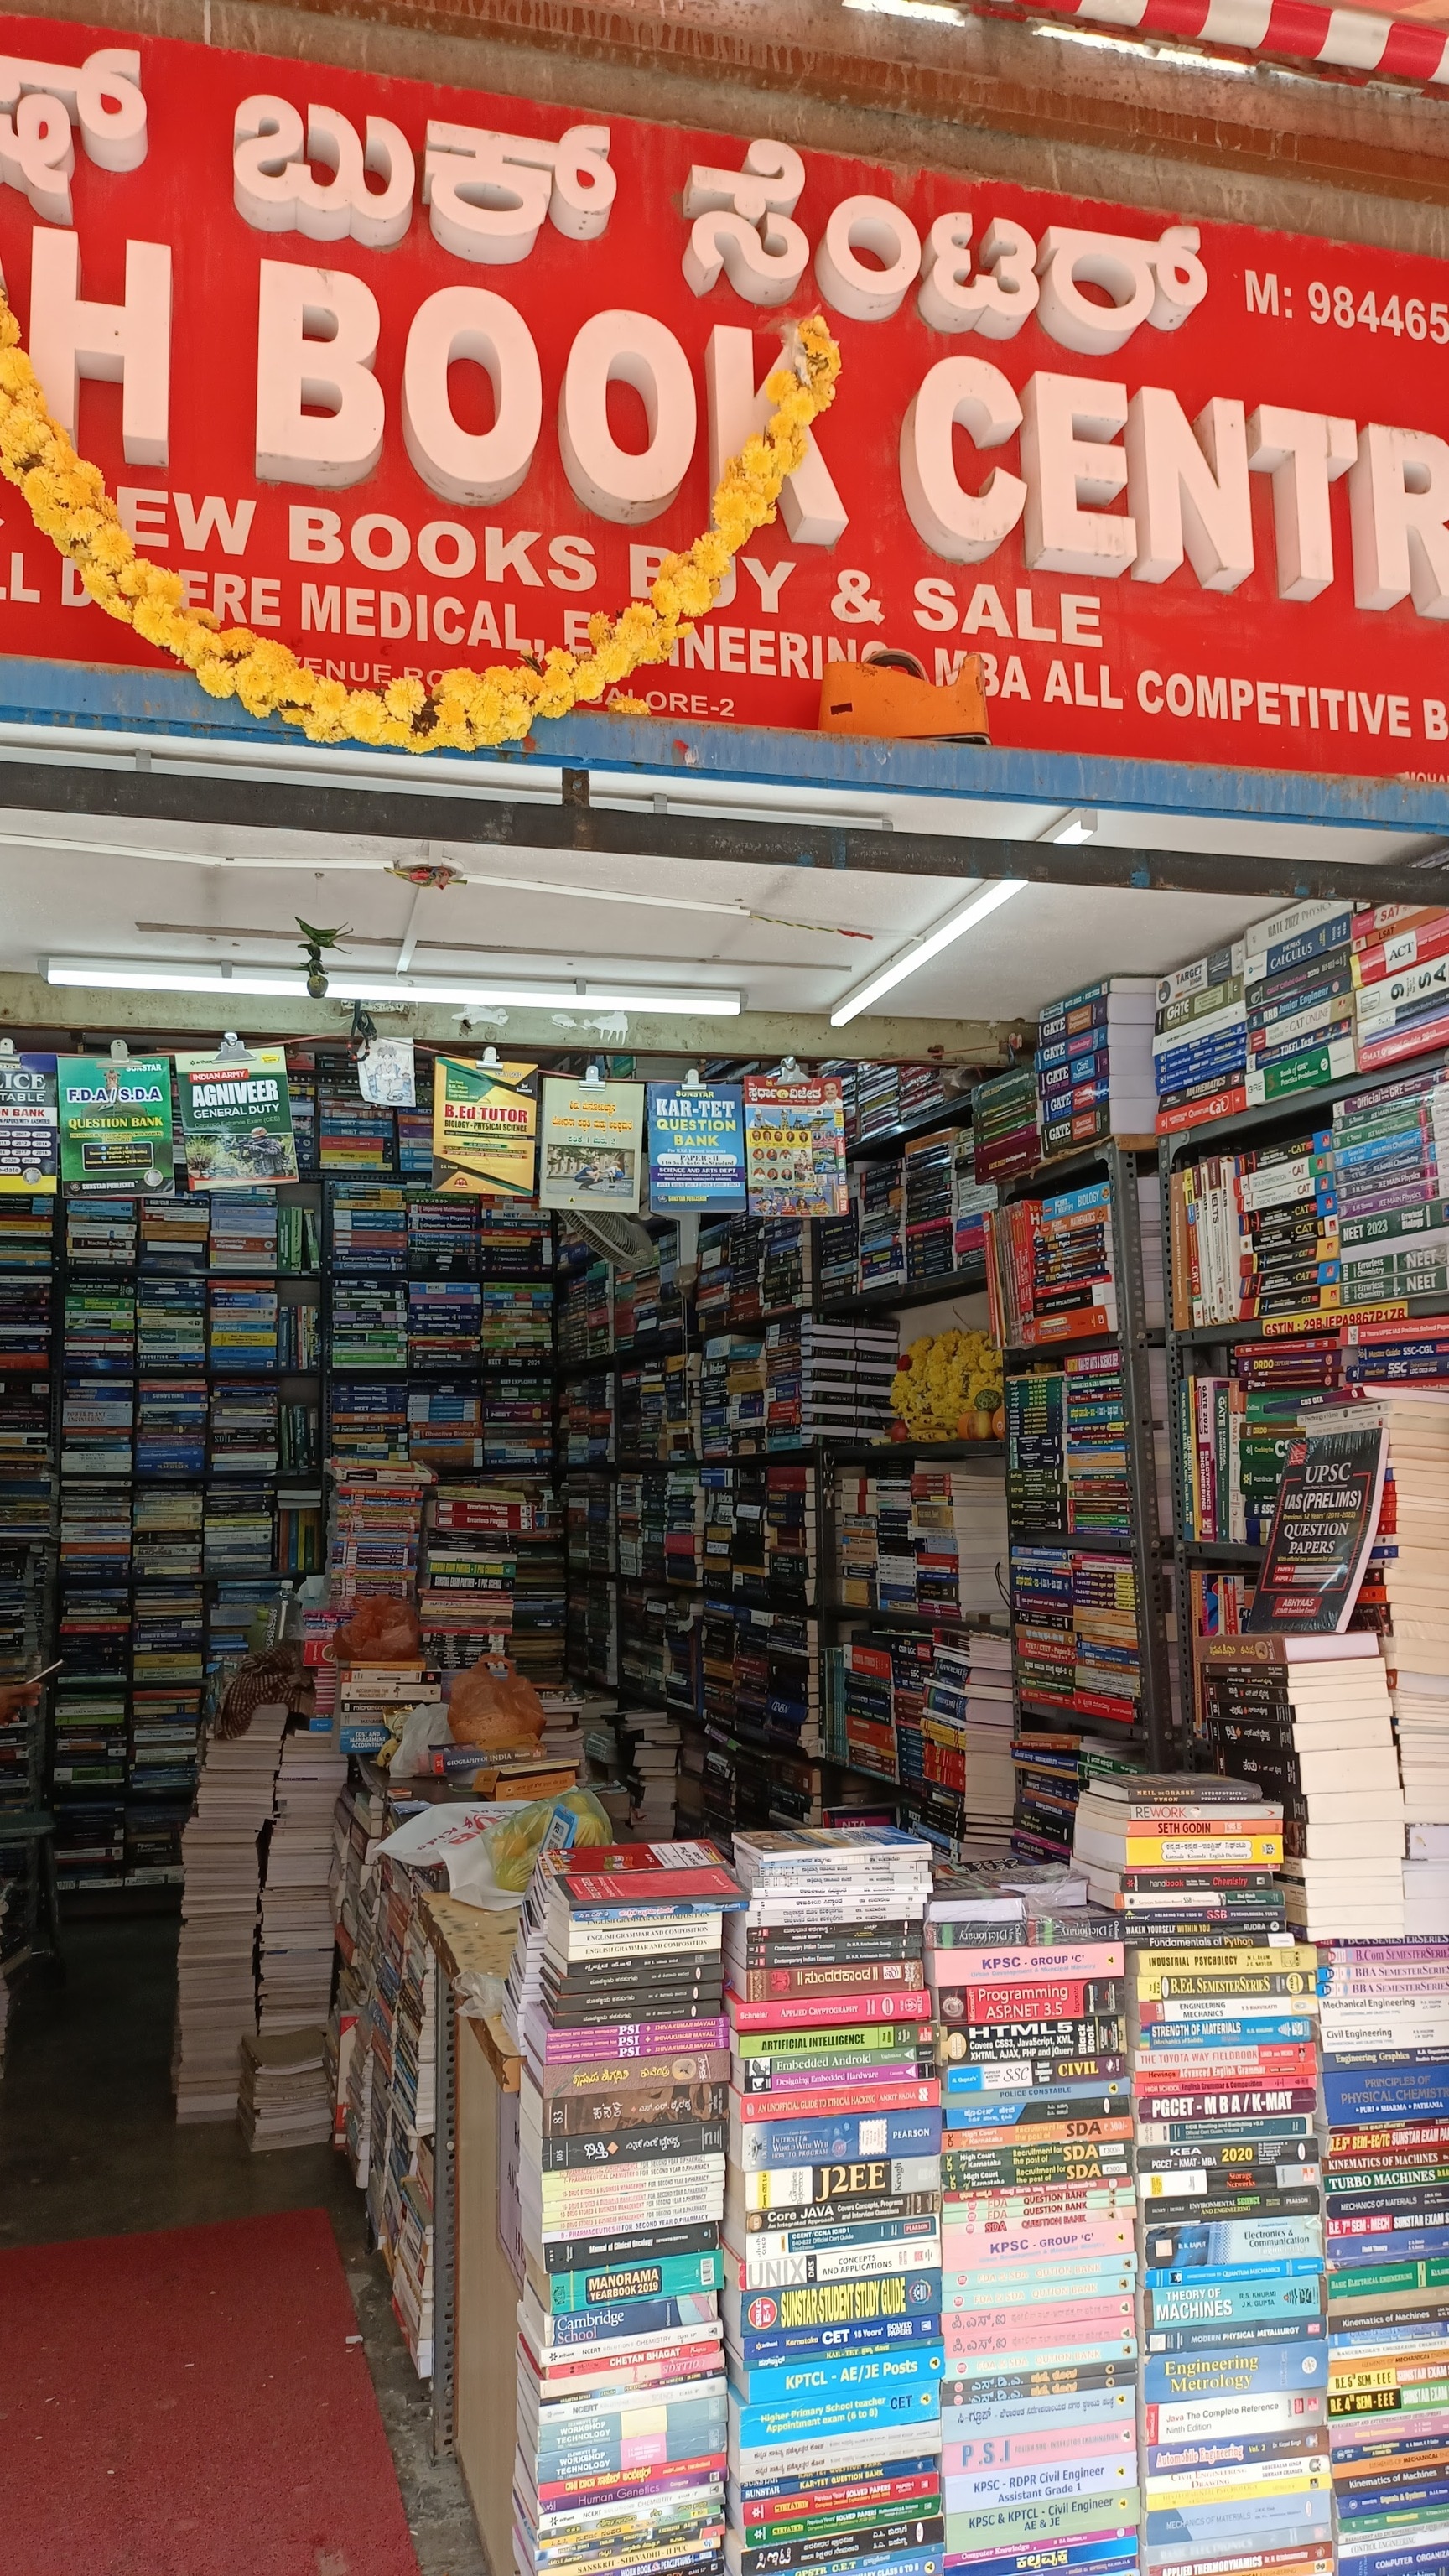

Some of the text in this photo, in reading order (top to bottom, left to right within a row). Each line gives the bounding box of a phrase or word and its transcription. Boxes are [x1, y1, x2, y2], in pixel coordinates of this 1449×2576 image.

[233, 95, 617, 264] ಬುಕ್
[683, 140, 1208, 355] ಸೆಂಟರ್
[1244, 269, 1449, 345] M: 984465
[0, 225, 172, 467] H
[258, 258, 848, 547] BOOK
[102, 485, 257, 556] EW
[288, 502, 598, 592] BOOKS
[830, 569, 886, 625] &
[913, 578, 1103, 647] SALE
[0, 550, 40, 604] L
[301, 583, 546, 668] MEDICAL,
[564, 610, 891, 681] EINEERIN
[934, 647, 1032, 702] MBA
[1043, 658, 1124, 711] ALL
[1137, 671, 1413, 738] COMPETITIVE
[1422, 698, 1449, 741] B
[1270, 942, 1313, 970] CALCULUS
[1389, 940, 1415, 962] ACT
[1176, 964, 1202, 985] TARGET
[1299, 986, 1329, 1005] Engineer
[1166, 999, 1189, 1021] GATE
[1043, 1017, 1067, 1040] GATE
[1289, 1008, 1329, 1032] CAT ONLINE
[0, 1073, 46, 1090] LICE
[1248, 1081, 1264, 1094] GRE
[120, 1088, 161, 1101] S.D.A
[193, 1080, 278, 1107] AGNIVEER
[194, 1104, 280, 1119] GENERAL DUTY
[444, 1104, 527, 1123] B.Ed TUTOR
[656, 1098, 735, 1118] KAR-TET
[68, 1117, 164, 1130] QUESTION BANK
[474, 1122, 501, 1130] PHYSICAL
[503, 1124, 527, 1132] SCIENCE
[657, 1119, 736, 1131] QUESTION
[674, 1135, 719, 1146] BANK
[1343, 1223, 1388, 1241] NEET 2023
[1358, 1281, 1384, 1291] Errorless
[1407, 1274, 1436, 1291] NEET
[1358, 1287, 1384, 1298] Chemistry
[1265, 1307, 1405, 1336] GSTIN 29BJEPA9867P1ZB
[1305, 1463, 1351, 1484] UPSC
[1284, 1523, 1349, 1537] QUESTION
[1288, 1541, 1334, 1554] PAPERS
[1282, 1598, 1314, 1607] ABHYAAS
[489, 1753, 512, 1763] INDIA
[1135, 1806, 1186, 1818] REWORK
[1158, 1822, 1211, 1833] SETH GODIN
[1207, 1909, 1228, 1919] SSB
[586, 1932, 614, 1941] ENGLISH
[615, 1930, 648, 1940] GRAMMAR
[665, 1926, 709, 1936] COMPOSITION
[1149, 1936, 1212, 1947] Fundamentals
[1223, 1937, 1253, 1949] Python
[982, 1956, 1021, 1969] KPSC
[1031, 1955, 1068, 1966] GROUP
[1149, 1955, 1238, 1967] INDUSTRIAL PSYCHOLOGY
[978, 1986, 1068, 2003] Programming
[781, 2006, 858, 2018] APPLIED CRYPTOGRAPHY
[1044, 2002, 1063, 2017] 3.5
[1179, 2002, 1226, 2010] ENGINEERING
[1323, 1997, 1415, 2010] Mechanical Engineering
[1182, 2010, 1223, 2018] MECHANICS
[618, 2024, 640, 2035] PSI
[969, 2022, 1073, 2039] HTML5
[1152, 2021, 1241, 2038] STRENGTH OF MATERIALS
[761, 2033, 865, 2051] ARTIFICIAL INTELLIGENCE
[776, 2054, 871, 2071] Embedded Android
[1058, 2061, 1099, 2076] CIVIL
[1152, 2099, 1195, 2118] PGCET
[892, 2128, 930, 2138] PEARSON
[1063, 2144, 1098, 2162] SDA
[1170, 2148, 1202, 2156] KEA
[1221, 2147, 1253, 2163] 2020
[1328, 2153, 1439, 2170] KINEMATICS OF MACHINES
[815, 2163, 886, 2203] J2EE
[894, 2162, 902, 2192] Keogh
[1328, 2170, 1436, 2189] TURBO MACHINES
[767, 2205, 834, 2222] Core JAVA
[822, 2261, 892, 2276] AND APPLICATIONS
[839, 2254, 876, 2266] CONCEPTS
[589, 2269, 659, 2291] MANORAMA
[748, 2256, 807, 2288] UNIX
[589, 2283, 659, 2301] YEARBOOK 2019
[1166, 2288, 1221, 2302] THEORY OF
[1156, 2299, 1233, 2321] MACHINES
[557, 2311, 625, 2331] Cambridge
[557, 2329, 597, 2345] School
[822, 2329, 850, 2345] CET
[609, 2348, 681, 2366] CHETAN BHAGAT
[786, 2359, 918, 2390] KPTCL AE/JE Posts
[1164, 2356, 1259, 2376] Engineering
[1170, 2373, 1253, 2393] Metrology
[891, 2395, 913, 2410] CET
[974, 2466, 1104, 2493] KPSC RDPR Civil Engineer
[578, 2485, 660, 2506] Human Genetics
[998, 2485, 1073, 2503] Assistant Grade
